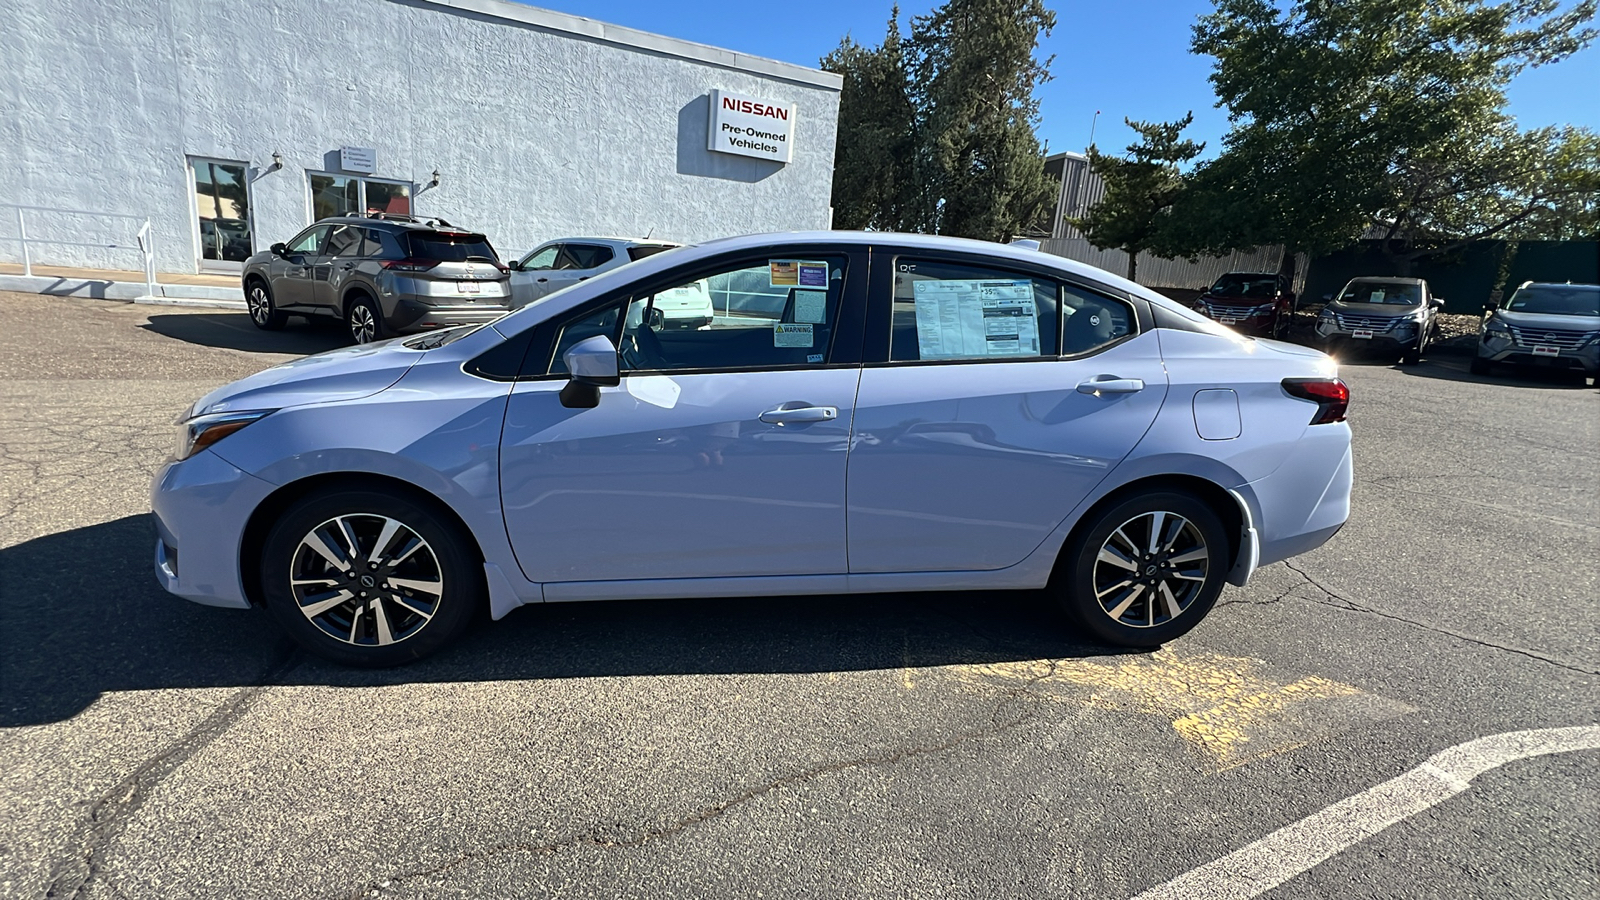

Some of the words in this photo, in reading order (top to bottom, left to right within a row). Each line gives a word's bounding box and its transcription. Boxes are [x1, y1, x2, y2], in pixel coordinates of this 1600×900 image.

[723, 97, 788, 120] NISSAN
[722, 123, 786, 142] Pre-Owned
[728, 137, 778, 153] Vehicles
